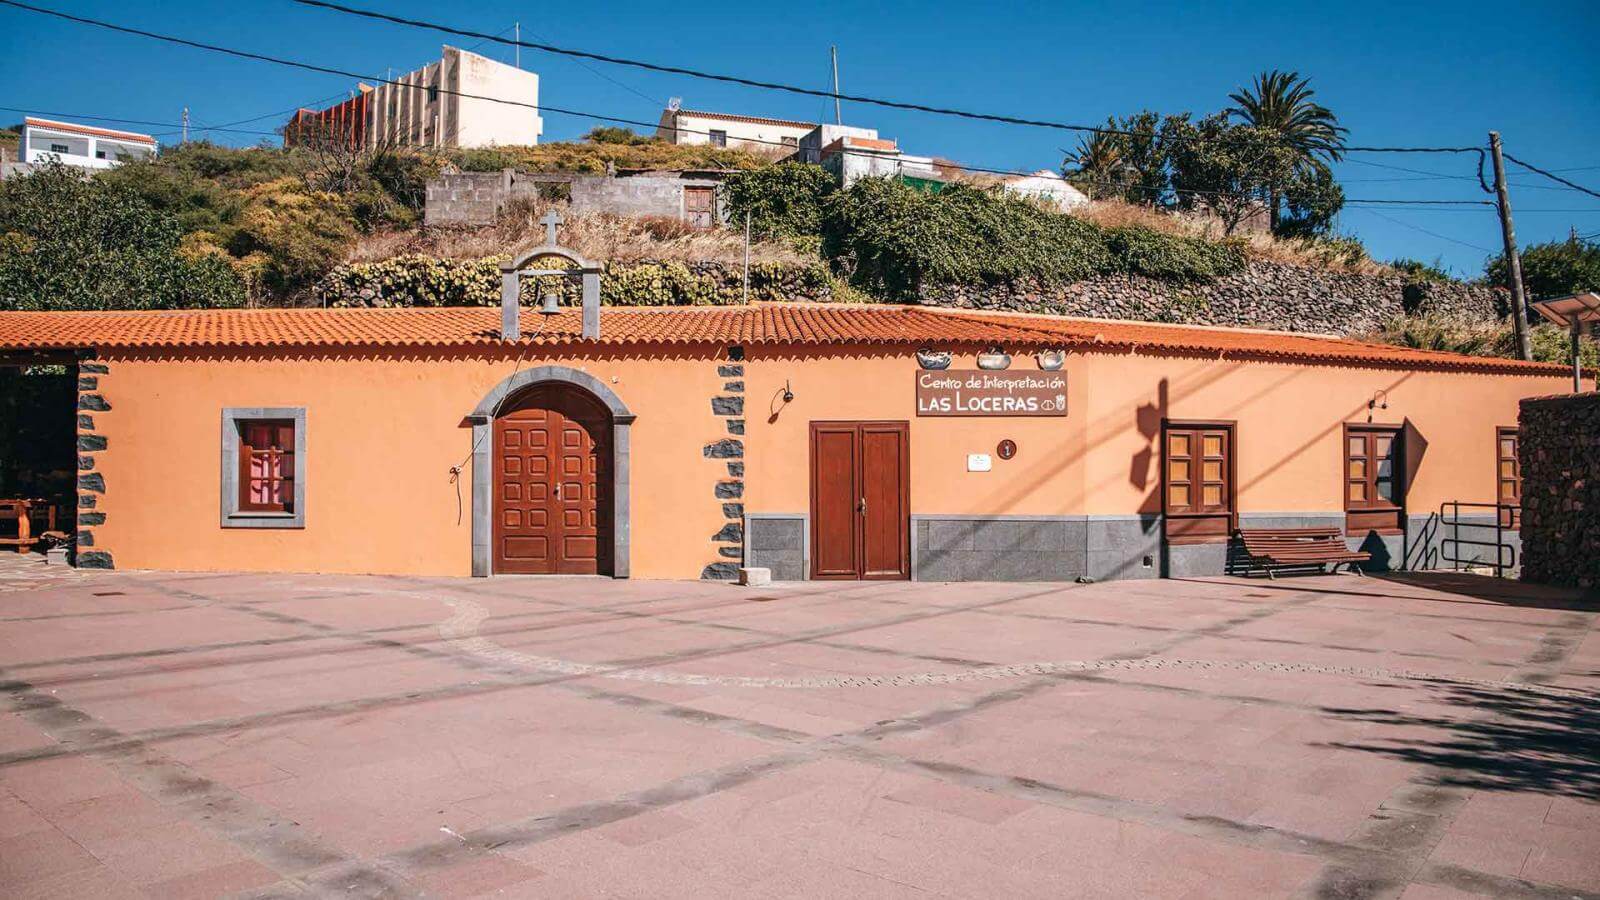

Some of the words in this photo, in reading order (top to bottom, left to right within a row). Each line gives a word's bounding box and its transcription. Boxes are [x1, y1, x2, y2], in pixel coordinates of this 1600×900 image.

[920, 373, 962, 389] Centro
[965, 375, 982, 389] de
[983, 375, 1066, 394] Interpretación
[919, 397, 951, 411] LAS
[956, 391, 1038, 411] LOCERAS
